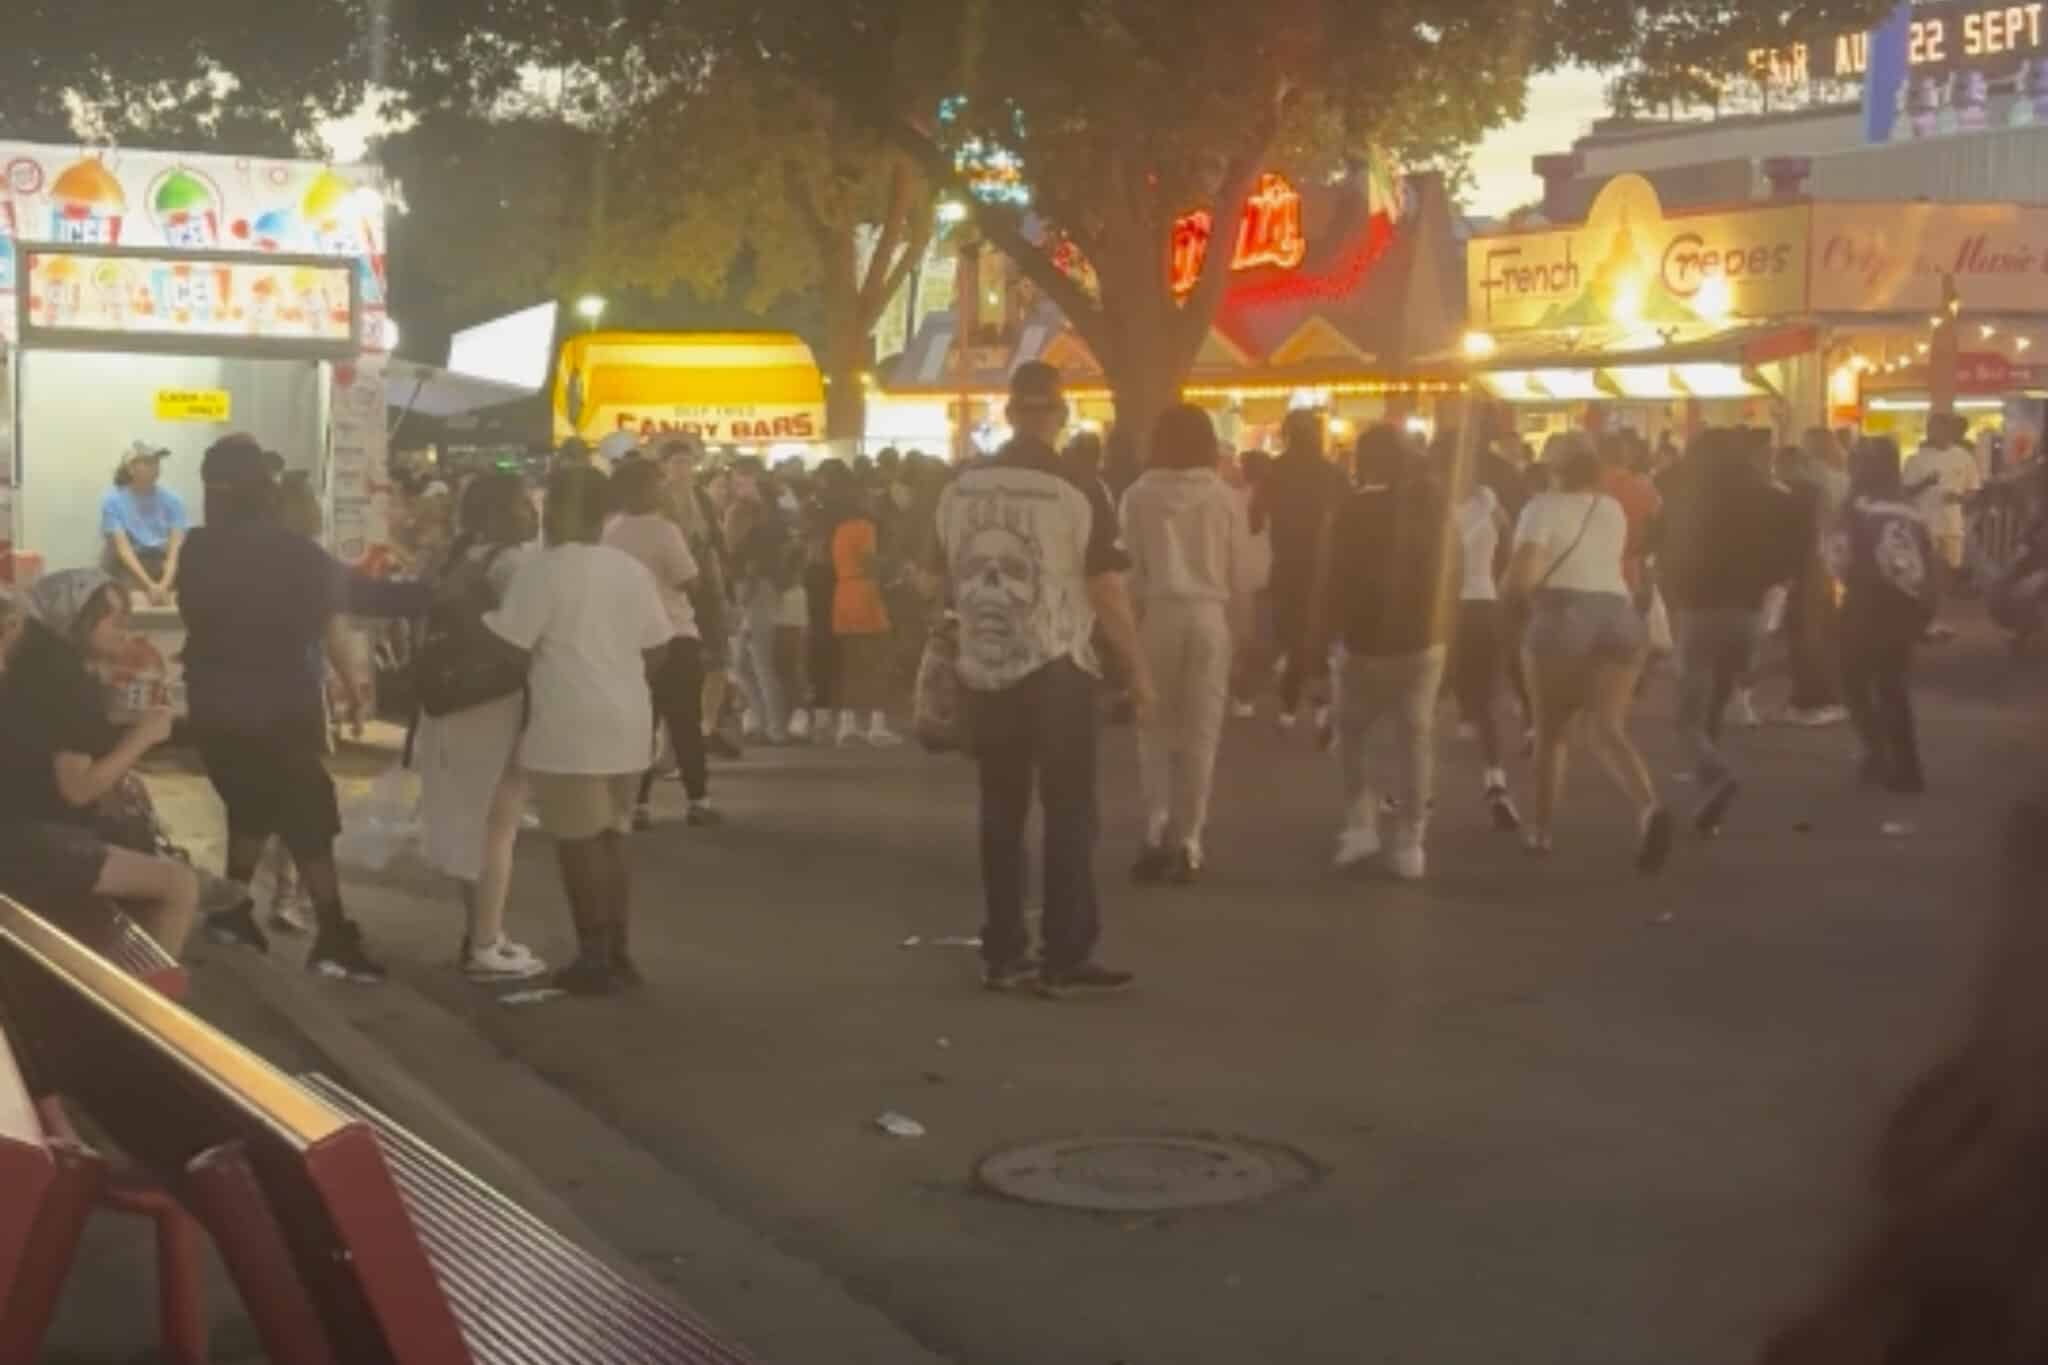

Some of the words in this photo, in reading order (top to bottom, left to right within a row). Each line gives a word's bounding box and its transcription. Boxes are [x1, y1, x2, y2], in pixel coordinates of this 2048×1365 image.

[1908, 19, 1946, 63] 22
[1963, 4, 2042, 55] SEPT
[1480, 236, 1579, 322] French
[731, 412, 813, 437] BARS
